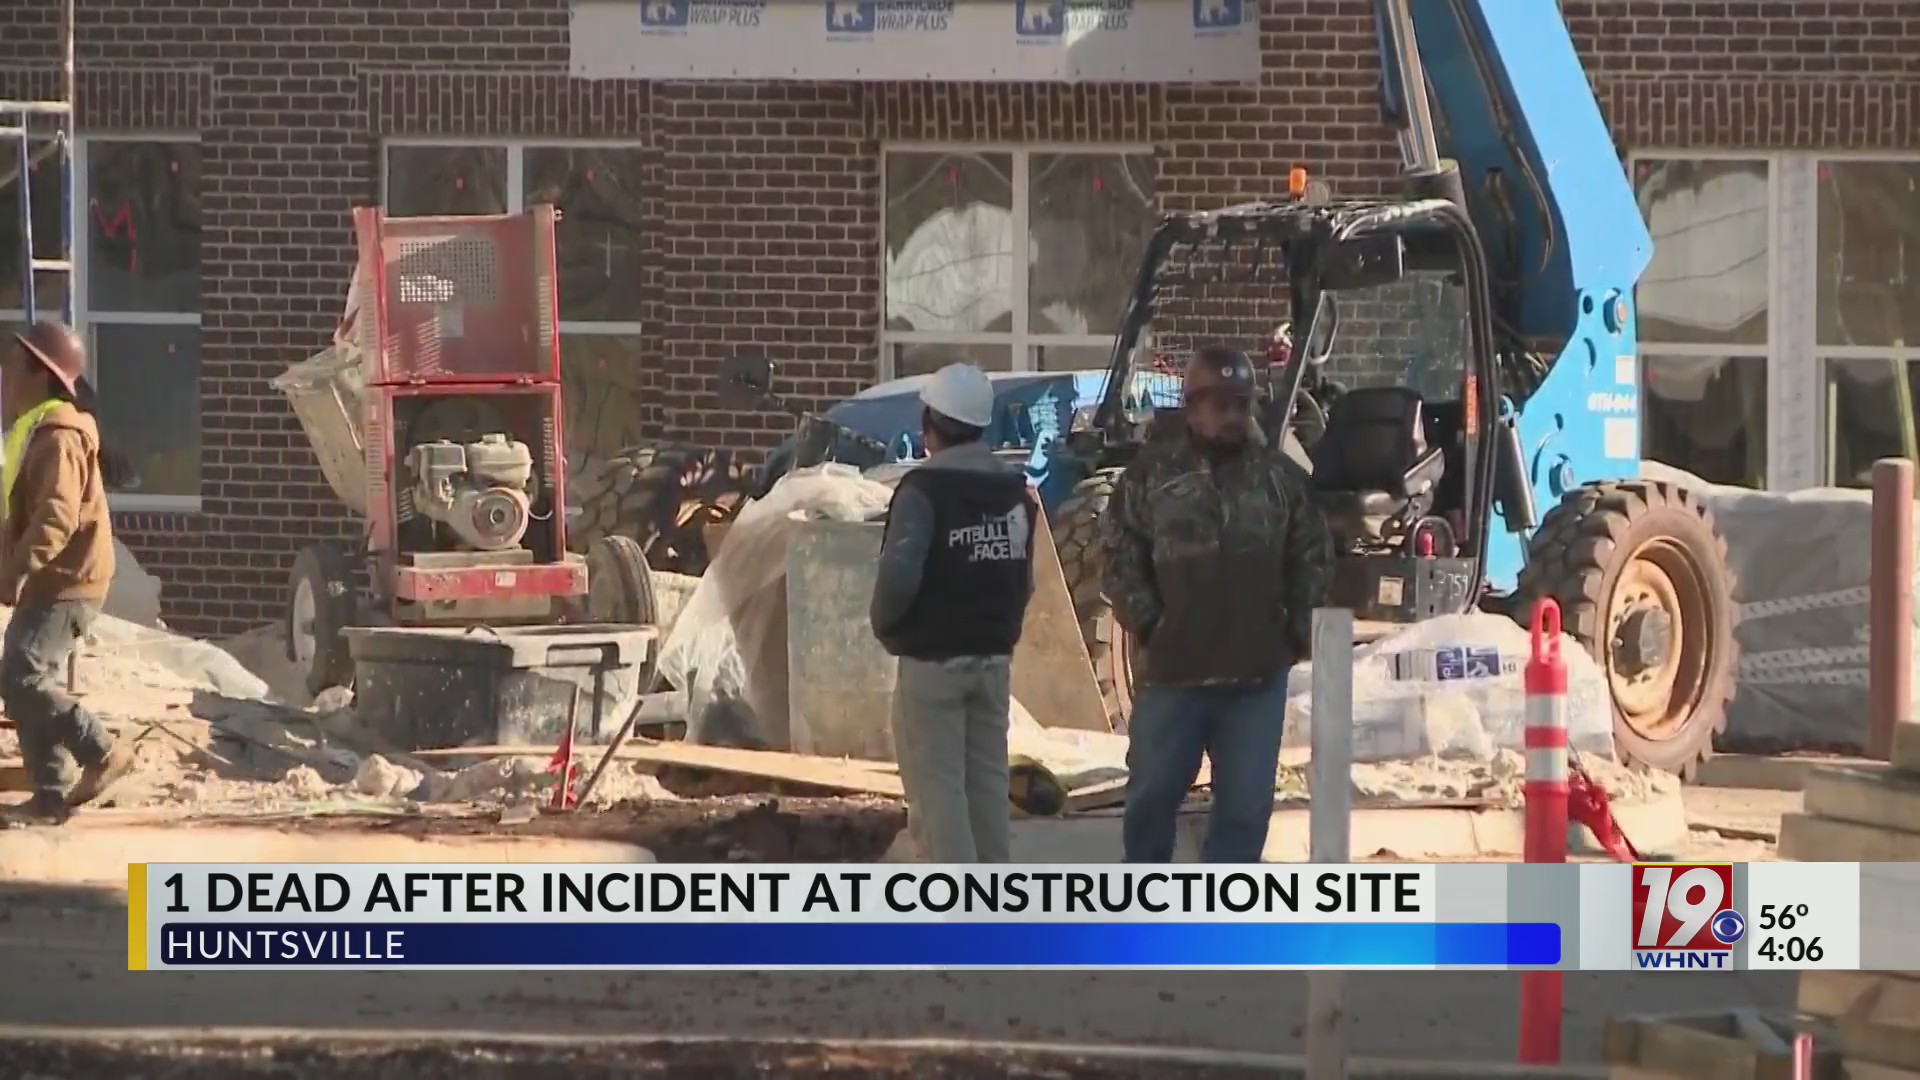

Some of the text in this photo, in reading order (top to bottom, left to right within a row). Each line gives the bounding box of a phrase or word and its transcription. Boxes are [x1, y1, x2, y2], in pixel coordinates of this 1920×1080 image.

[728, 7, 760, 26] PLUS
[877, 13, 948, 31] WRAP PLUS
[1098, 13, 1129, 31] PLUS
[949, 523, 1009, 547] PITBULL
[975, 541, 1009, 560] FACE
